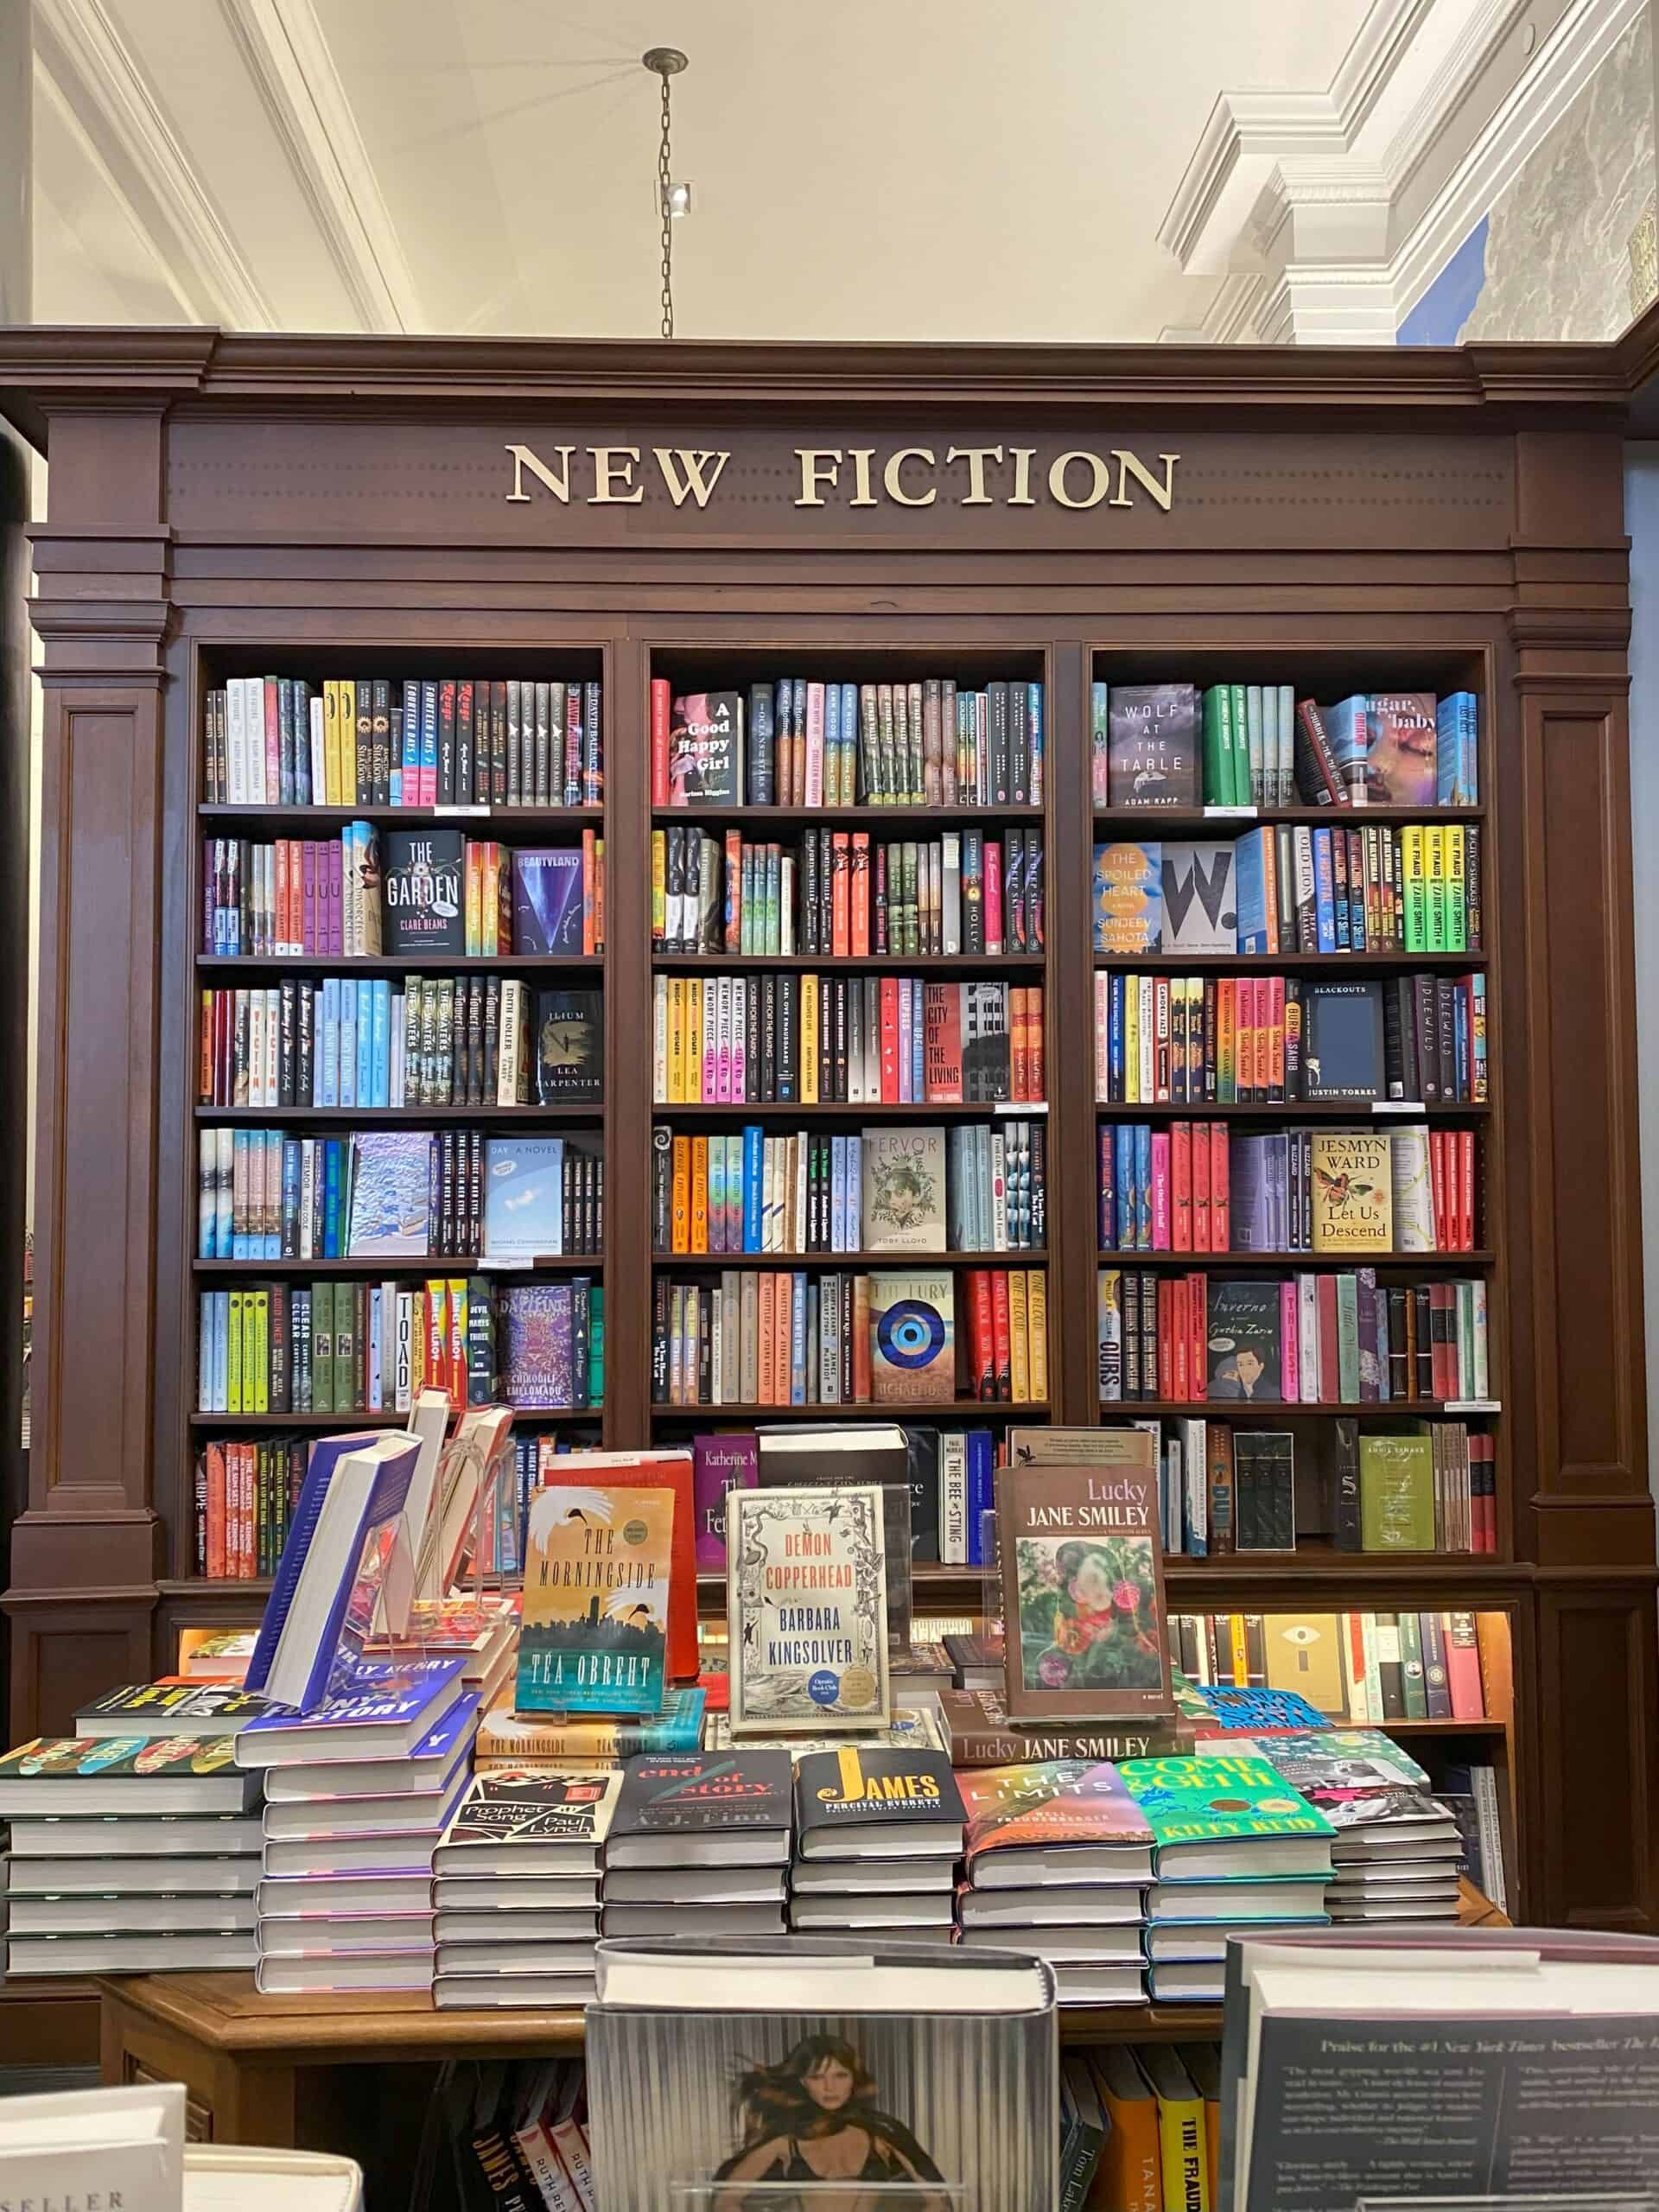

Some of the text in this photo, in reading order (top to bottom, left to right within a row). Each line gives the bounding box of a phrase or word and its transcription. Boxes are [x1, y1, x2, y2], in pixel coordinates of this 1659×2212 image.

[504, 444, 1180, 511] NEW FICTION
[715, 703, 729, 716] A
[1125, 704, 1178, 719] WOLF
[425, 686, 435, 753] FOURTEEN DAYS
[689, 721, 729, 735] Good
[1143, 724, 1160, 734] AT
[678, 739, 728, 753] Happy
[1138, 741, 1166, 751] THE
[697, 756, 728, 771] Girl
[1122, 758, 1182, 771] TABLE
[410, 842, 432, 863] THE
[1112, 853, 1136, 864] THE
[518, 856, 580, 868] BEAUTYLAND
[1300, 836, 1312, 897] OLD LION
[1029, 864, 1038, 889] DEEP
[1097, 871, 1151, 880] SPOILED
[388, 875, 459, 906] GARDEN
[1103, 886, 1145, 897] HEART
[401, 919, 448, 931] CLARE BEAMS
[969, 906, 978, 943] HOLLY
[1101, 933, 1148, 942] SAHOTA
[928, 987, 944, 1002] THE
[440, 991, 449, 1050] THE WATERS
[549, 1012, 583, 1020] ILIUM
[928, 1007, 947, 1023] CITY
[1440, 986, 1451, 1056] IDLEWILD
[504, 1017, 512, 1050] HOLLER
[929, 1027, 940, 1044] OF
[929, 1047, 945, 1064] THE
[1287, 1044, 1299, 1071] SAHIB
[735, 1070, 742, 1078] KO
[929, 1067, 959, 1084] LIVING
[869, 1137, 937, 1153] FERVOR
[1319, 1140, 1386, 1153] JESMYN
[1327, 1156, 1380, 1168] WARD
[1329, 1207, 1379, 1219] Let Us
[1322, 1224, 1386, 1237] Descend
[909, 1284, 947, 1299] FURY
[1032, 1274, 1043, 1329] ONE BLOOD
[399, 1297, 409, 1388] TOAD
[705, 1451, 748, 1466] Katherine
[195, 1483, 207, 1510] RIPE
[1088, 1478, 1147, 1506] Lucky
[949, 1459, 962, 1543] THE BEE STING
[1027, 1506, 1149, 1528] JANE SMILEY
[584, 1529, 614, 1555] THE
[785, 1535, 832, 1556] DEMON
[539, 1560, 656, 1589] MORNINGSIDE
[766, 1564, 852, 1590] COPPERHEAD
[779, 1607, 840, 1632] BARBARA
[769, 1640, 852, 1666] KINGSOLVER
[531, 1651, 650, 1688] TÉA OBREHT
[302, 1700, 420, 1723] STORY
[963, 1737, 1150, 1759] Lucky JANE SMILEY
[638, 1766, 702, 1780] end
[817, 1749, 940, 1802] JAMES
[1121, 1758, 1260, 1777] COME
[714, 1771, 745, 1783] of
[996, 1771, 1077, 1789] THE
[678, 1783, 775, 1796] story
[970, 1780, 1113, 1801] LIMITS
[465, 1805, 545, 1815] Prophet
[825, 1798, 941, 1810] PERCIVAL EVERETT
[474, 1813, 526, 1822] Song
[544, 1817, 585, 1826] Paul
[632, 1812, 771, 1827] A. J. Finn
[530, 1825, 590, 1834] Lynch
[1161, 1818, 1318, 1840] KILEY REID
[1320, 2039, 1365, 2053] Praise
[1368, 2041, 1389, 2053] for
[1393, 2041, 1415, 2053] the
[1420, 2039, 1438, 2053] #1
[1443, 2040, 1470, 2053] New
[1475, 2041, 1503, 2053] York
[1507, 2040, 1546, 2053] Times
[1551, 2039, 1618, 2051] bestseller
[1182, 2117, 1198, 2152] THE
[472, 2132, 519, 2191] JAMES
[572, 2153, 592, 2186] RUTH
